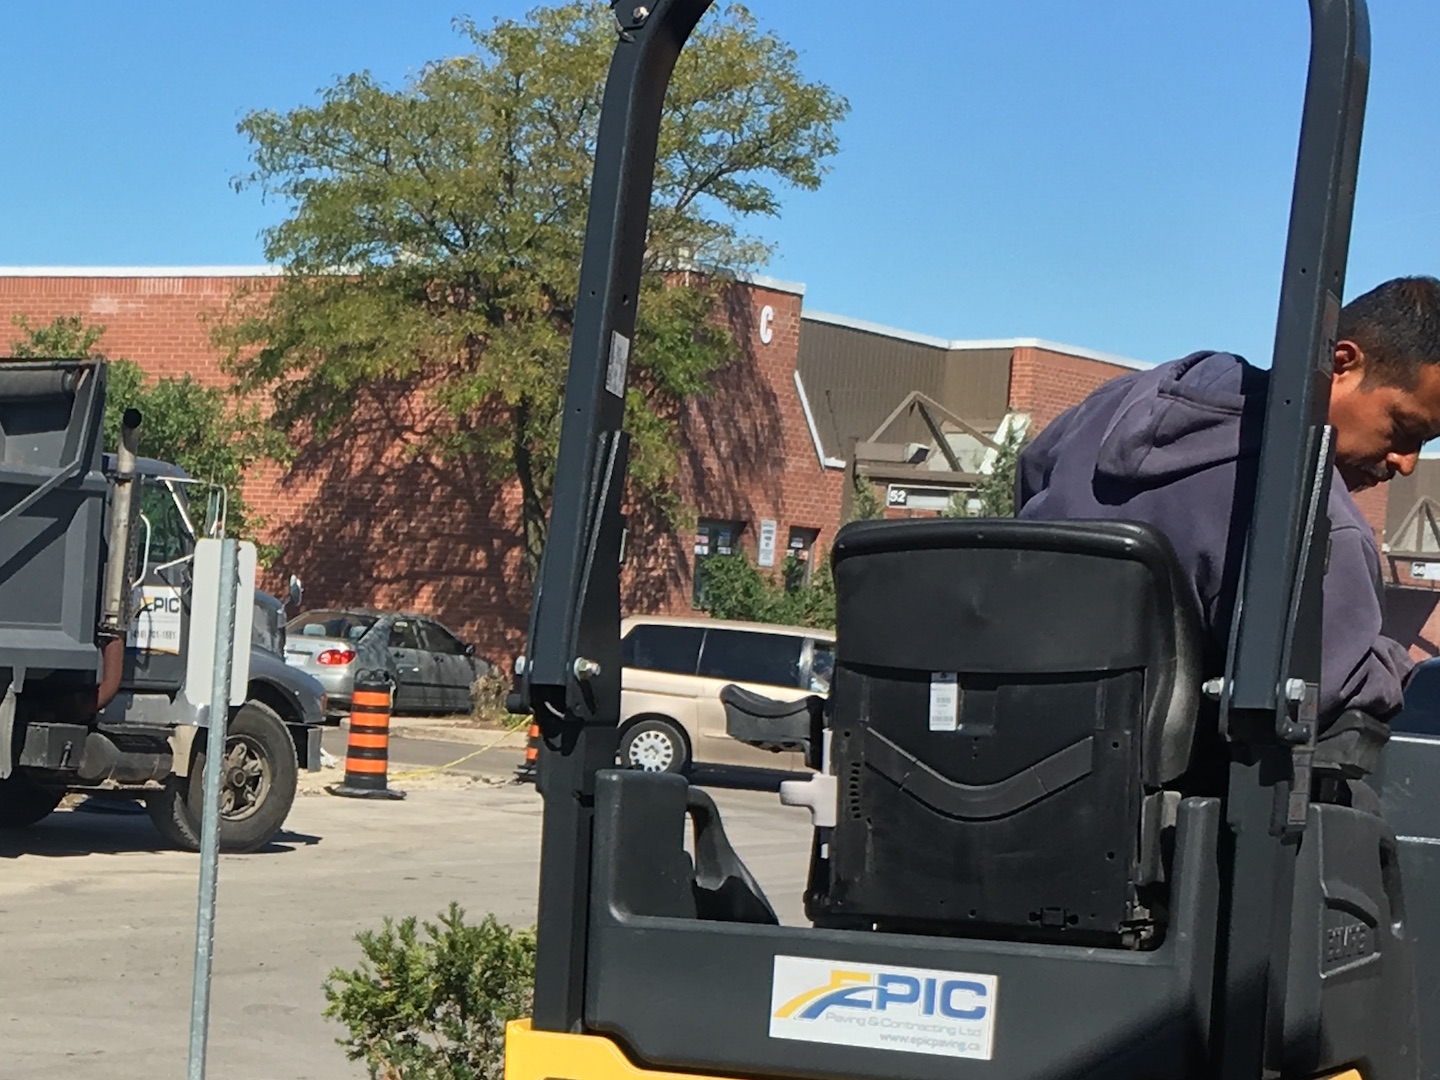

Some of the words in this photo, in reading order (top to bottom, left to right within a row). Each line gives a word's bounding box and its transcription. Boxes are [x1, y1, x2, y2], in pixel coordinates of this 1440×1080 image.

[759, 305, 774, 344] C
[889, 489, 907, 503] 52
[825, 1011, 867, 1028] Paving
[868, 1016, 880, 1027] &
[880, 1017, 956, 1037] Contracting
[958, 1025, 982, 1037] Ltd
